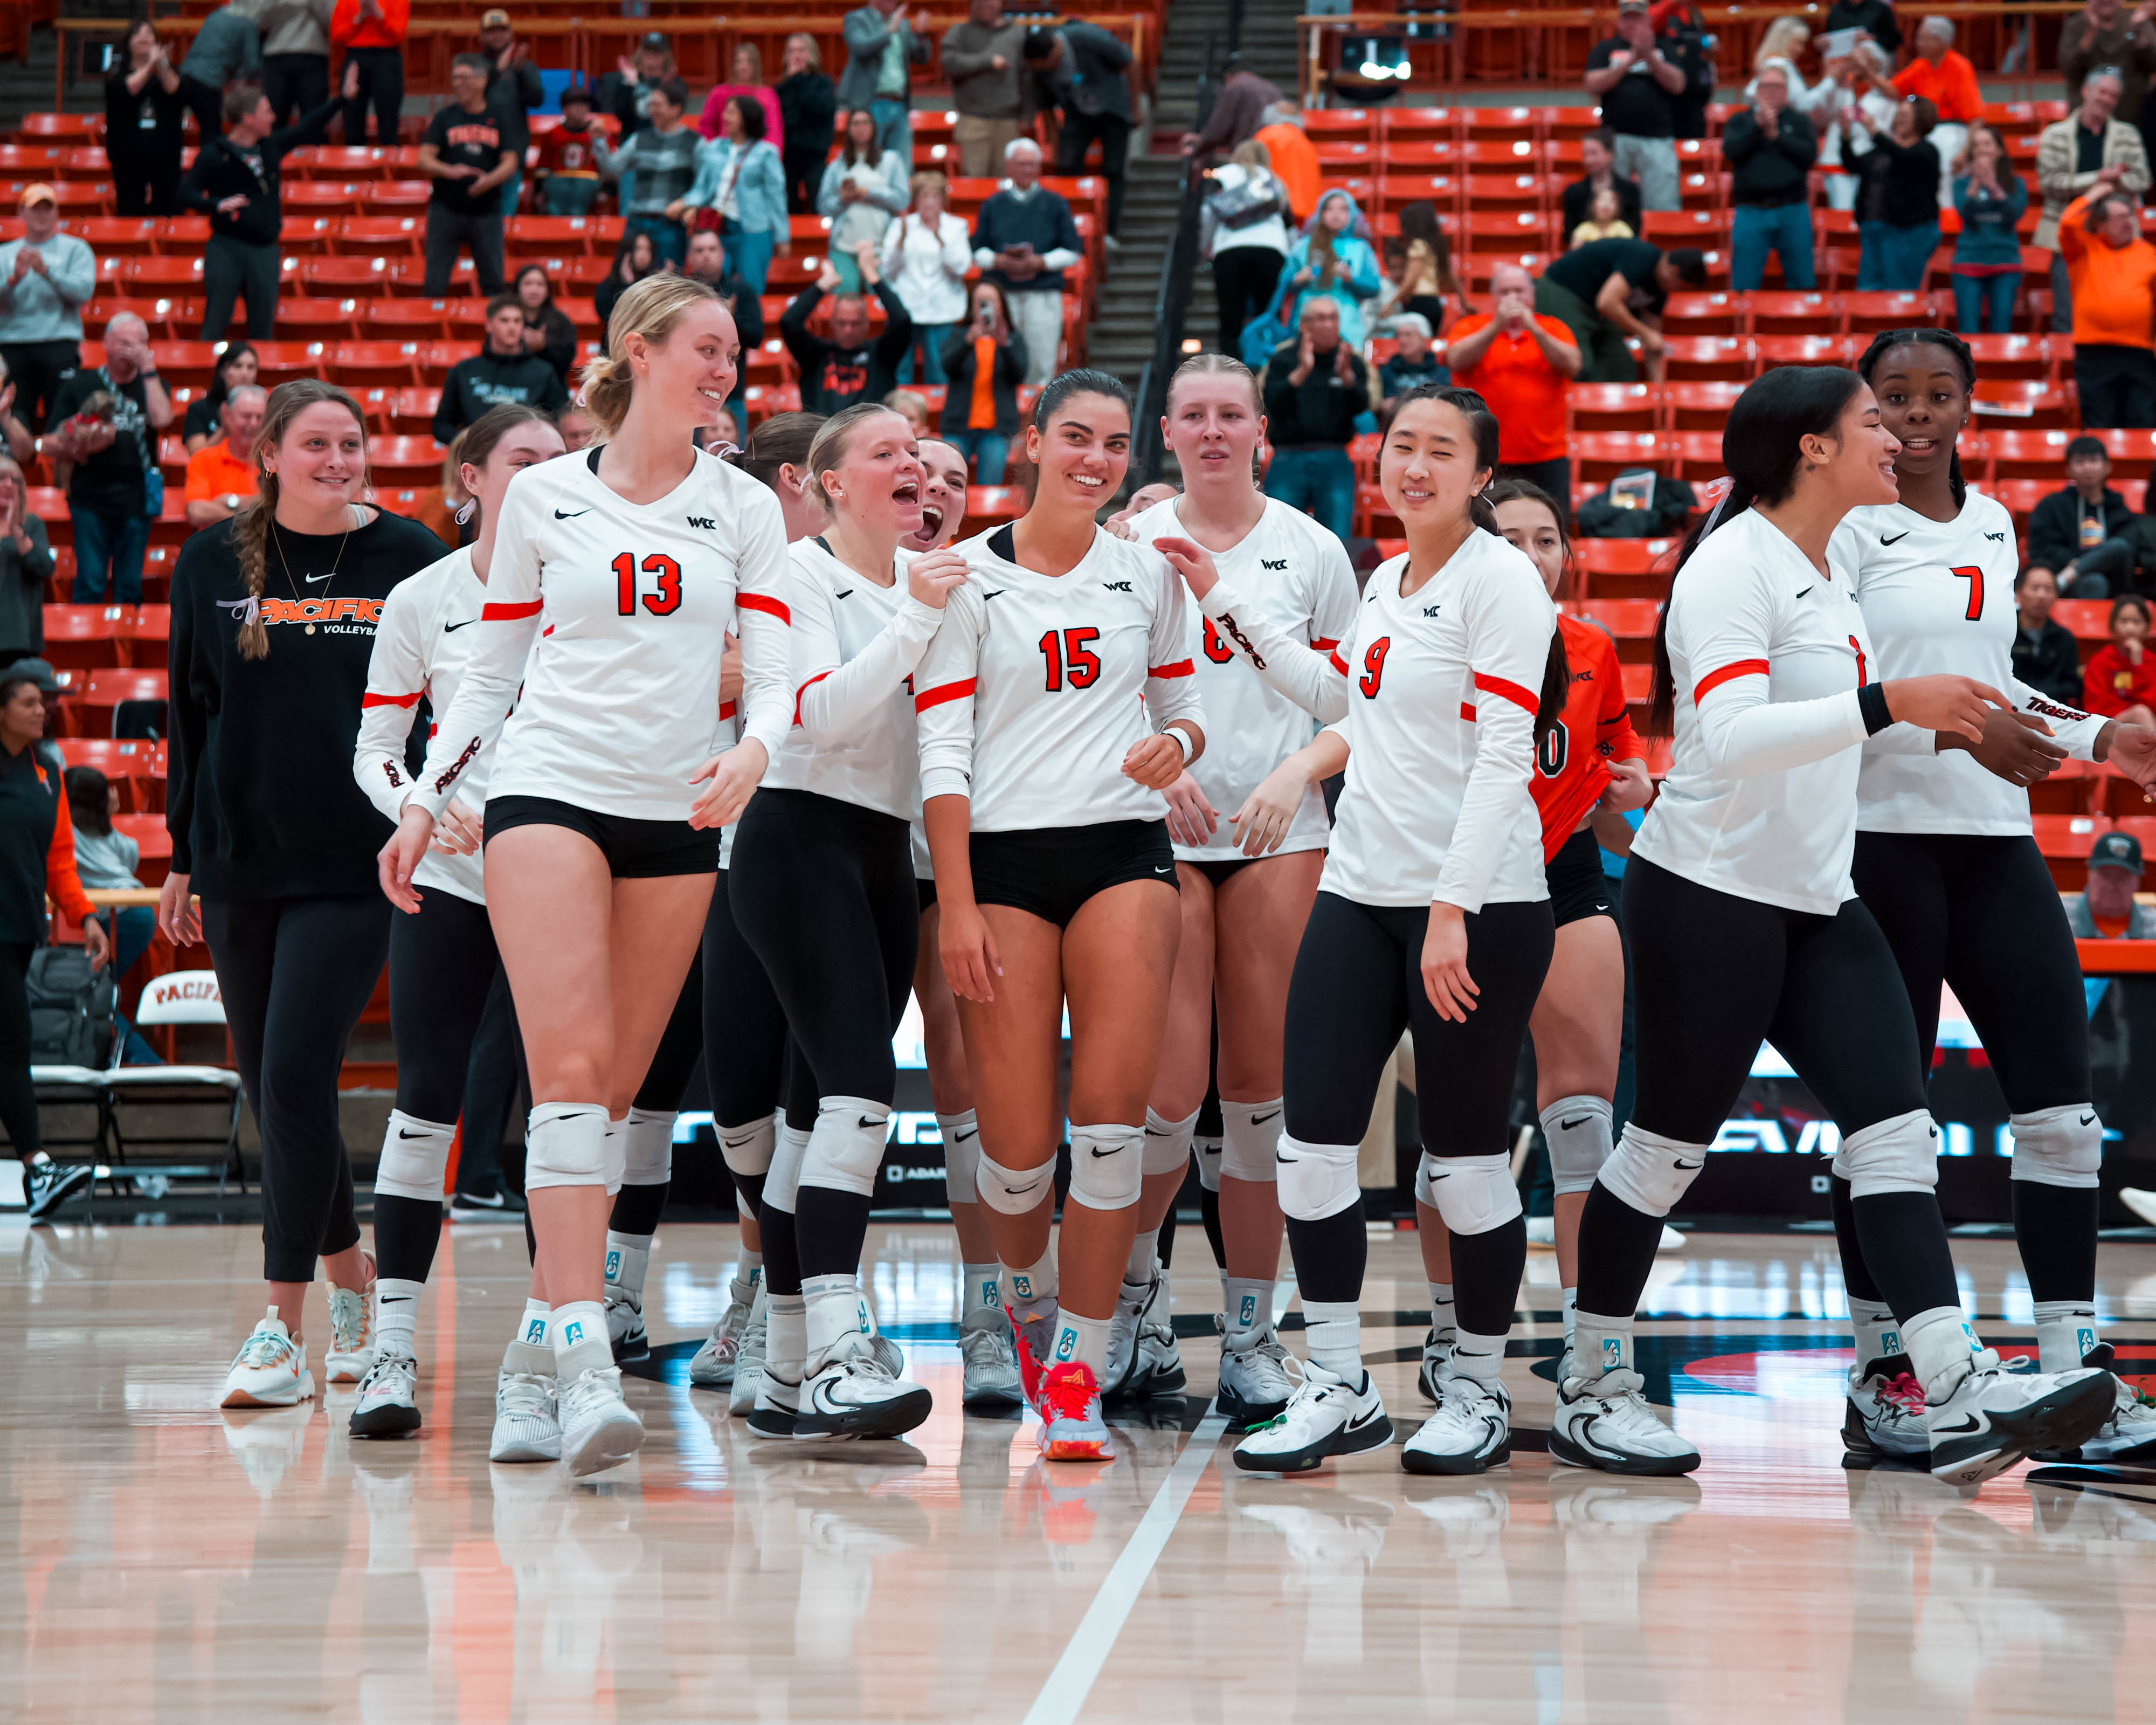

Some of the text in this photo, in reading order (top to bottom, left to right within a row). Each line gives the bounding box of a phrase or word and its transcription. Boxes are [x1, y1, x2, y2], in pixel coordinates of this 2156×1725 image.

[686, 516, 716, 530] WCC
[611, 551, 683, 616] 13
[1103, 581, 1132, 592] WCC
[1260, 558, 1288, 570] WCC
[260, 597, 385, 625] PACIFIC
[1949, 565, 1984, 621] 7
[1039, 626, 1101, 692] 15
[1216, 612, 1267, 670] PACIFIC
[1359, 636, 1390, 699] 9
[2026, 696, 2091, 721] TIGERS
[434, 736, 482, 795] PACIFIC
